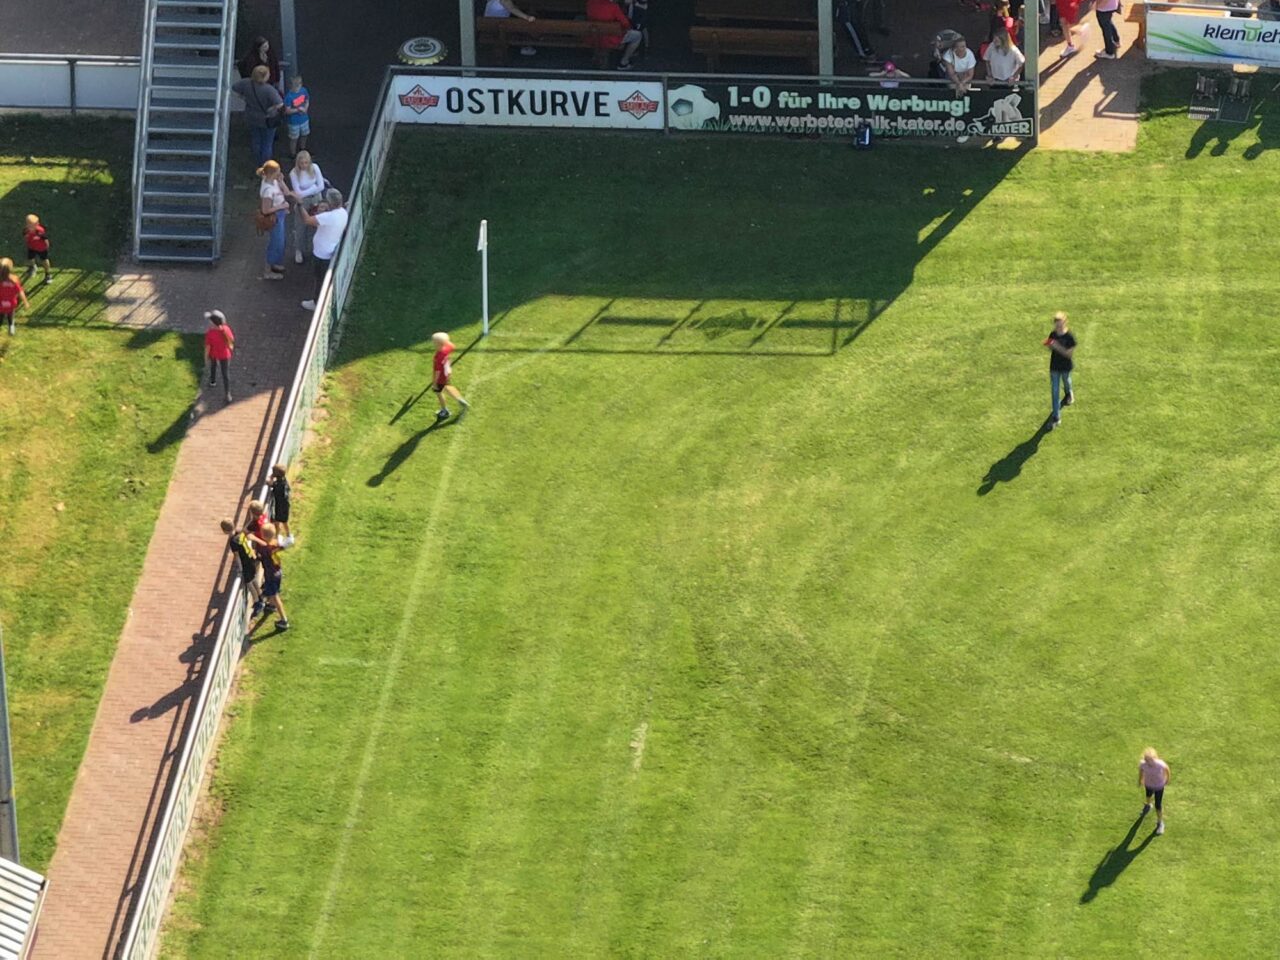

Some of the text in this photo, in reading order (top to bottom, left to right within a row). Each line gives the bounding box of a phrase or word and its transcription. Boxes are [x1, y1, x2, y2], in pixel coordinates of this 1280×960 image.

[446, 86, 610, 118] OSTKURVE
[727, 86, 971, 117] 1-0 für Ihre Werbung!
[991, 121, 1031, 135] KATER
